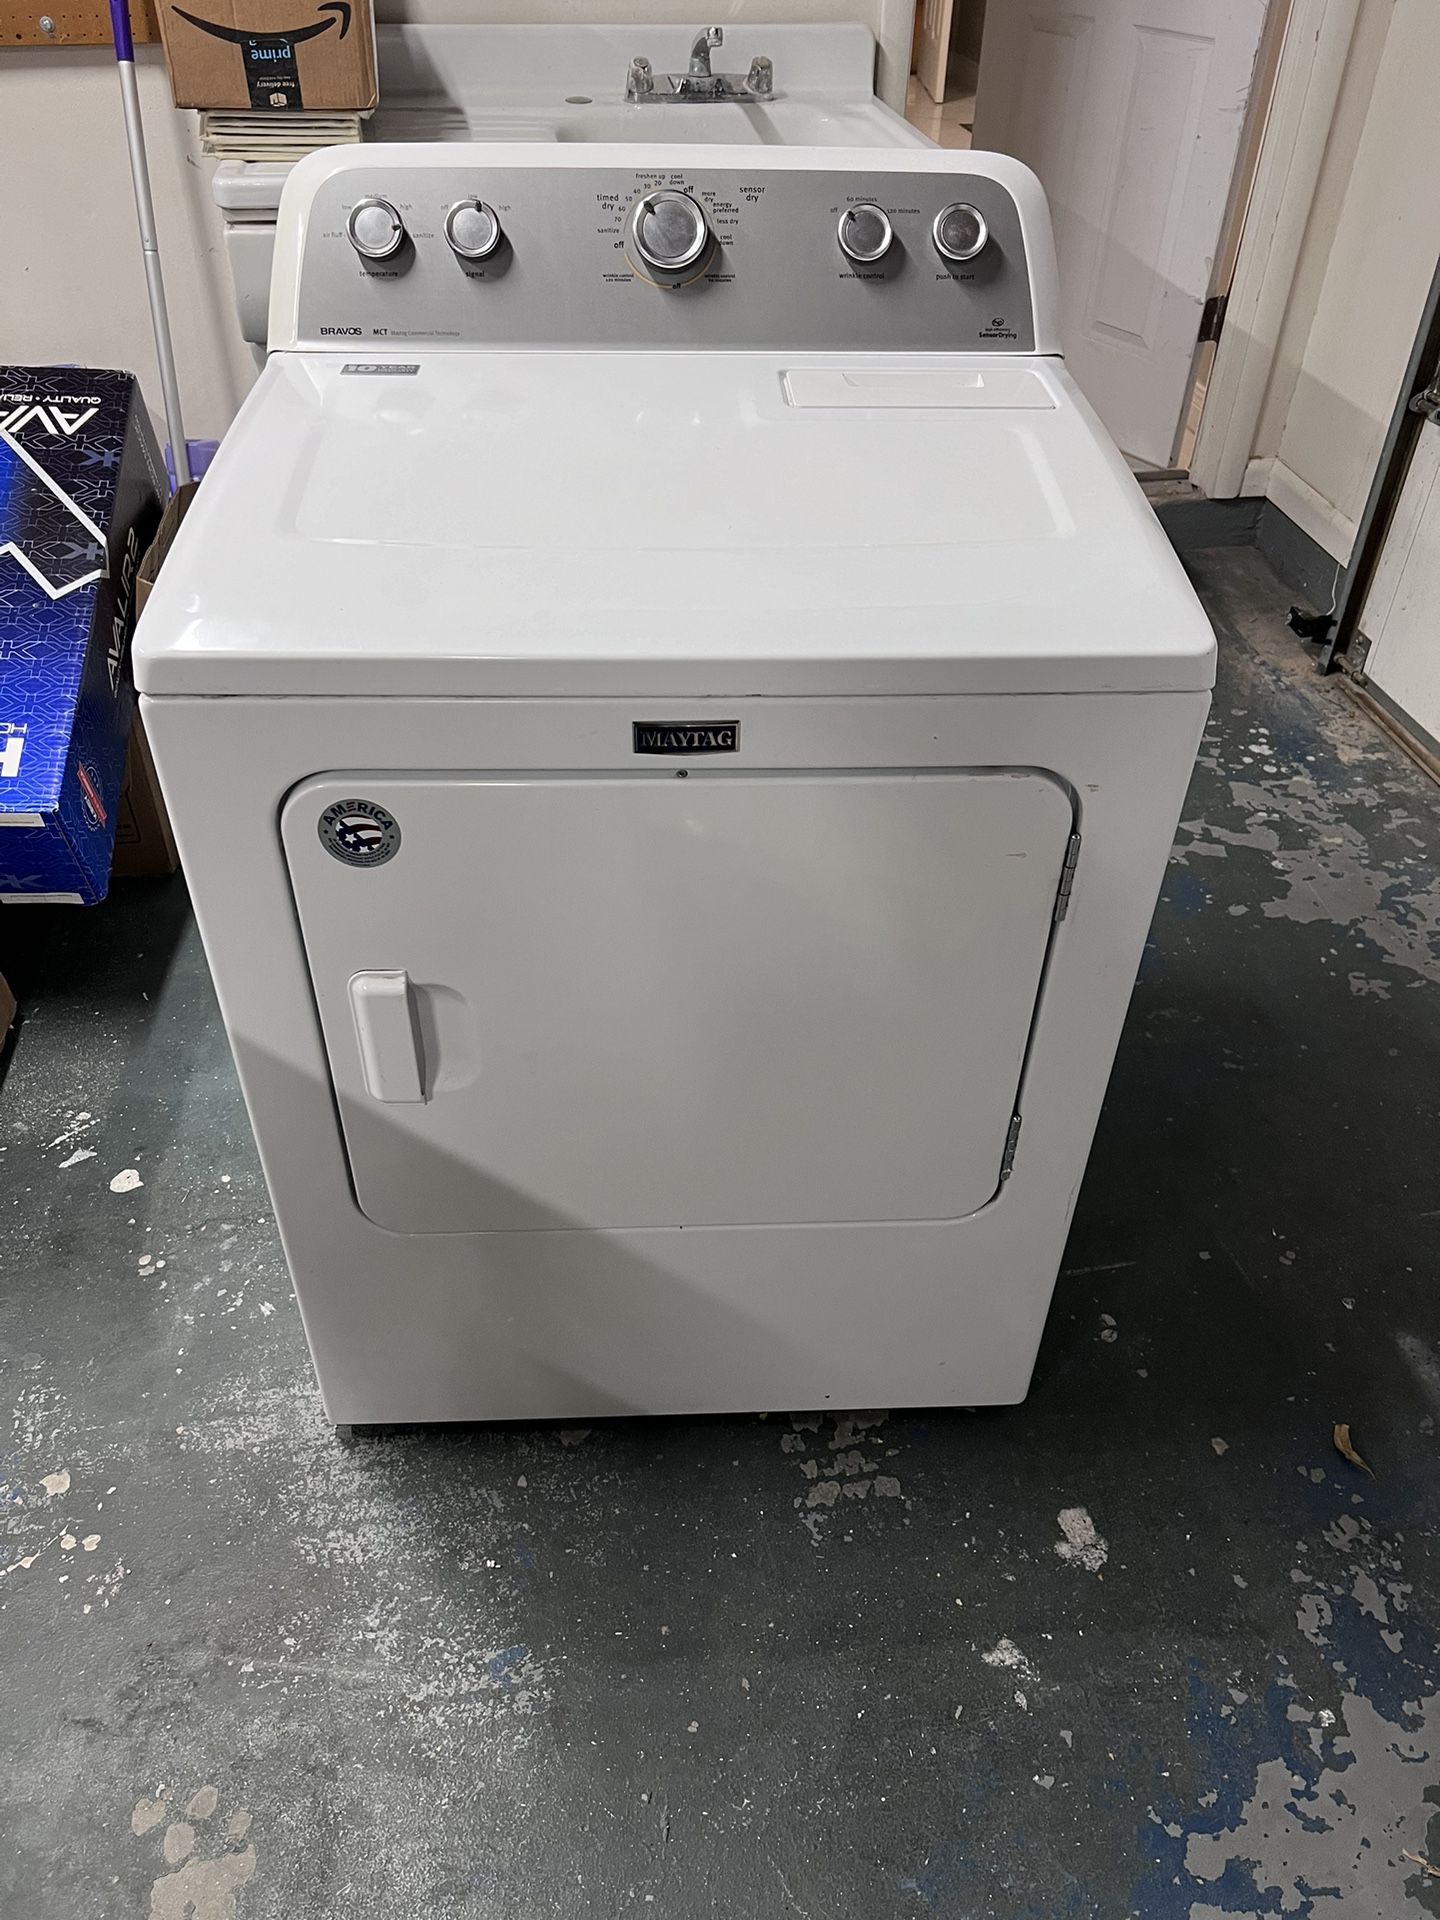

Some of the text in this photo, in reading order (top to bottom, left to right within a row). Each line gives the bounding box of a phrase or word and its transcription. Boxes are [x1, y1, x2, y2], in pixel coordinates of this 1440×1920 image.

[251, 45, 291, 63] prime
[256, 81, 282, 89] delivery
[683, 185, 694, 194] off
[739, 186, 765, 194] sensor
[596, 193, 620, 202] timed
[746, 194, 758, 202] dry
[602, 202, 614, 211] dry
[614, 240, 624, 249] off
[359, 270, 398, 278] temperature
[465, 270, 485, 279] signal
[862, 272, 885, 280] control
[320, 327, 362, 336] BRAVOS
[373, 328, 388, 336] MCT
[42, 395, 101, 405] QUALITY
[107, 526, 138, 691] AVALIR2
[639, 730, 733, 747] MAYTAG
[323, 801, 394, 831] AMERICA
